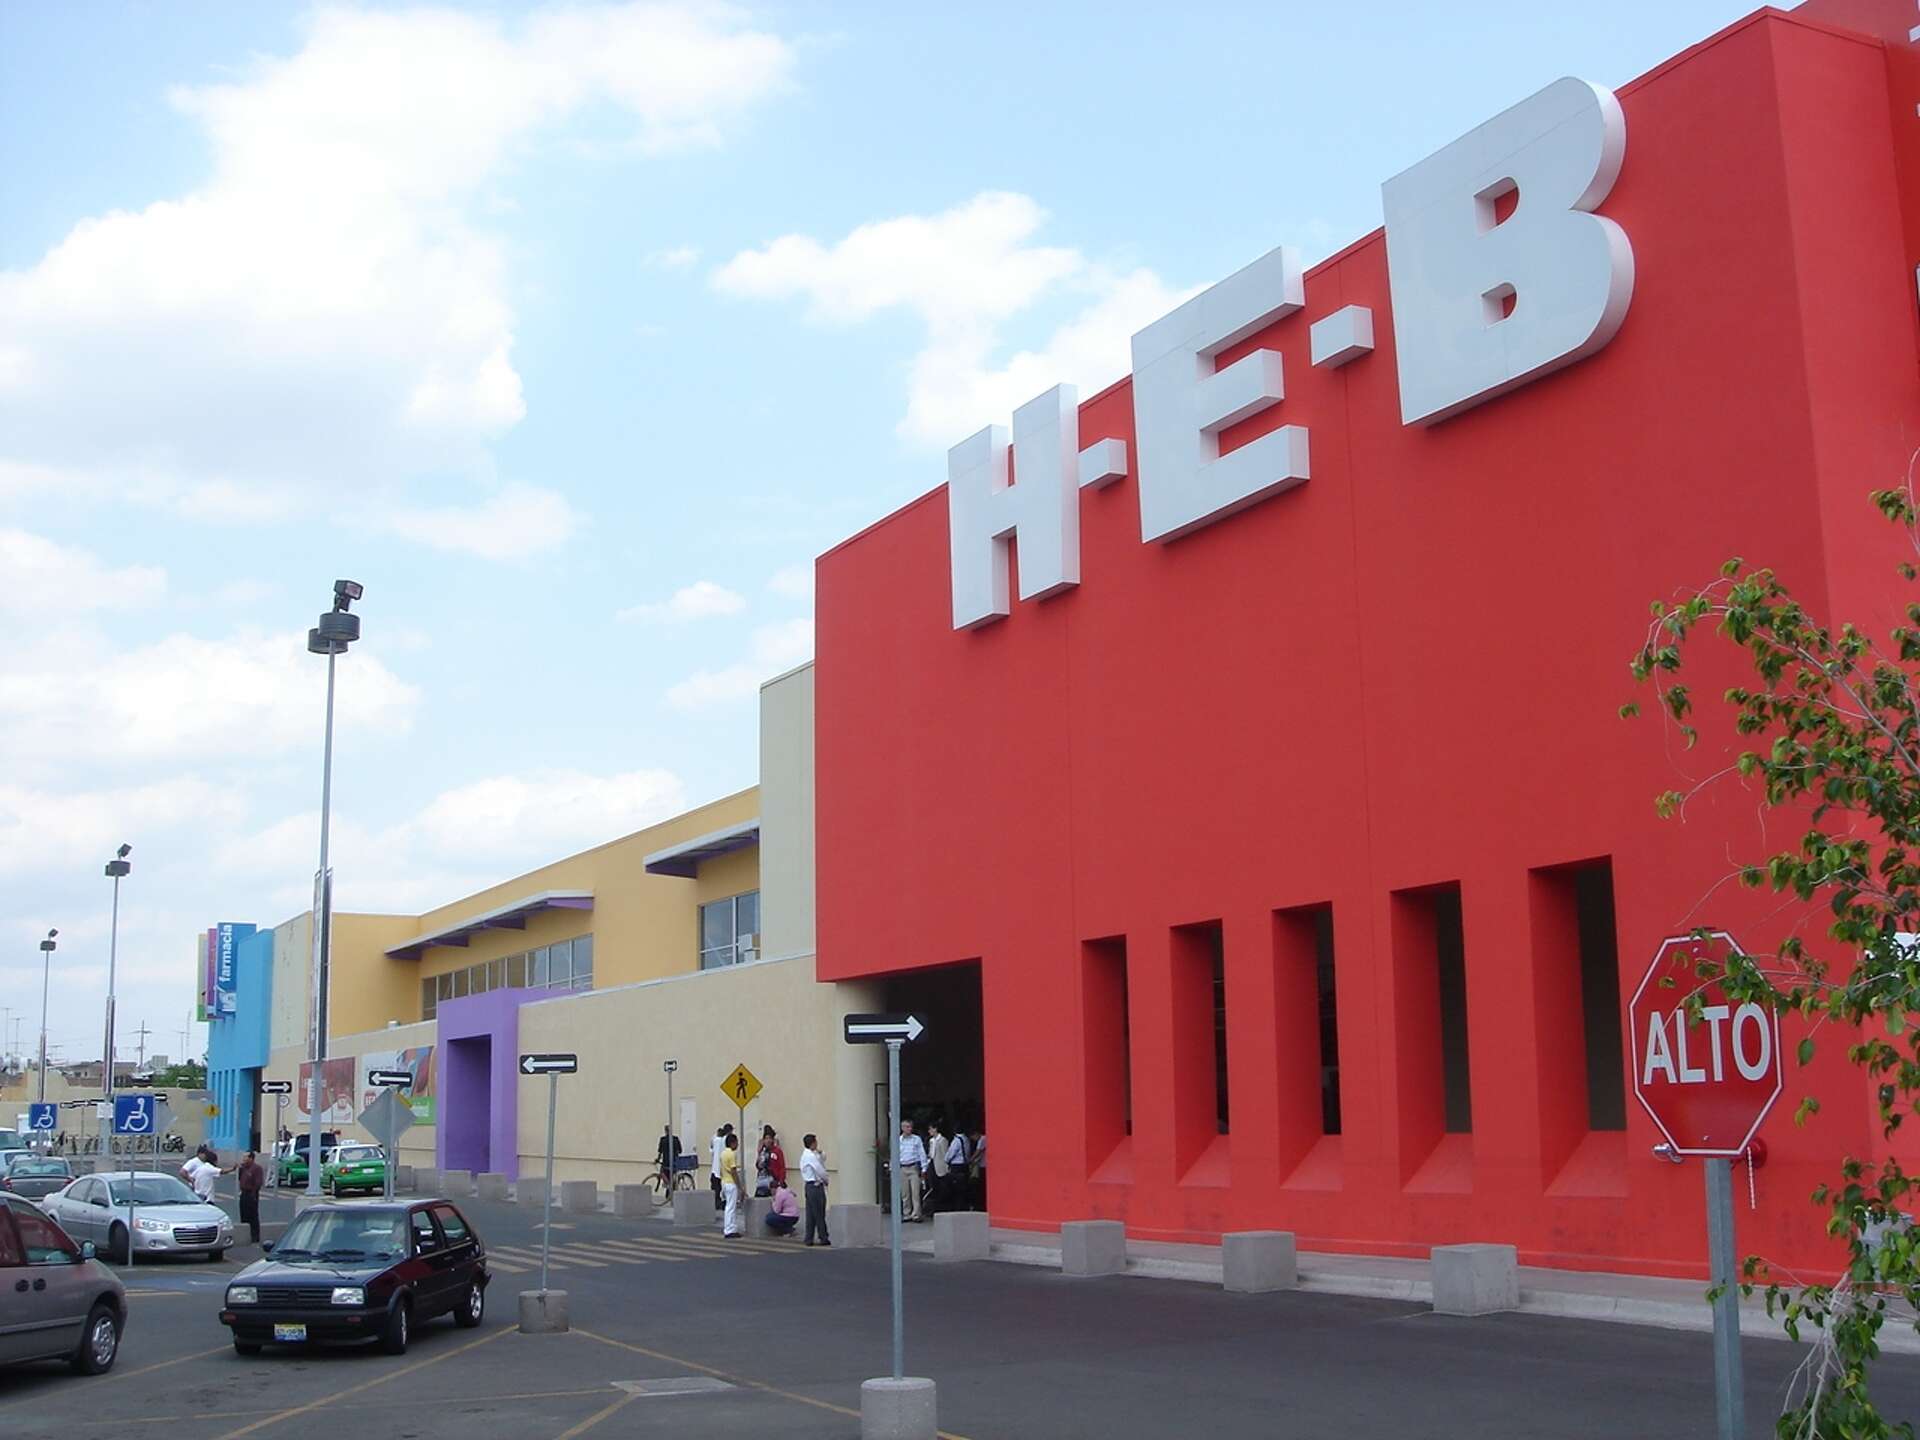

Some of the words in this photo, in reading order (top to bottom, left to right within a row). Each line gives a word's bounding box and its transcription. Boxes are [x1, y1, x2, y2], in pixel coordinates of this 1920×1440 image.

[948, 77, 1636, 632] H-E-B
[219, 924, 232, 982] farmacia
[1642, 1001, 1772, 1086] ALTO
